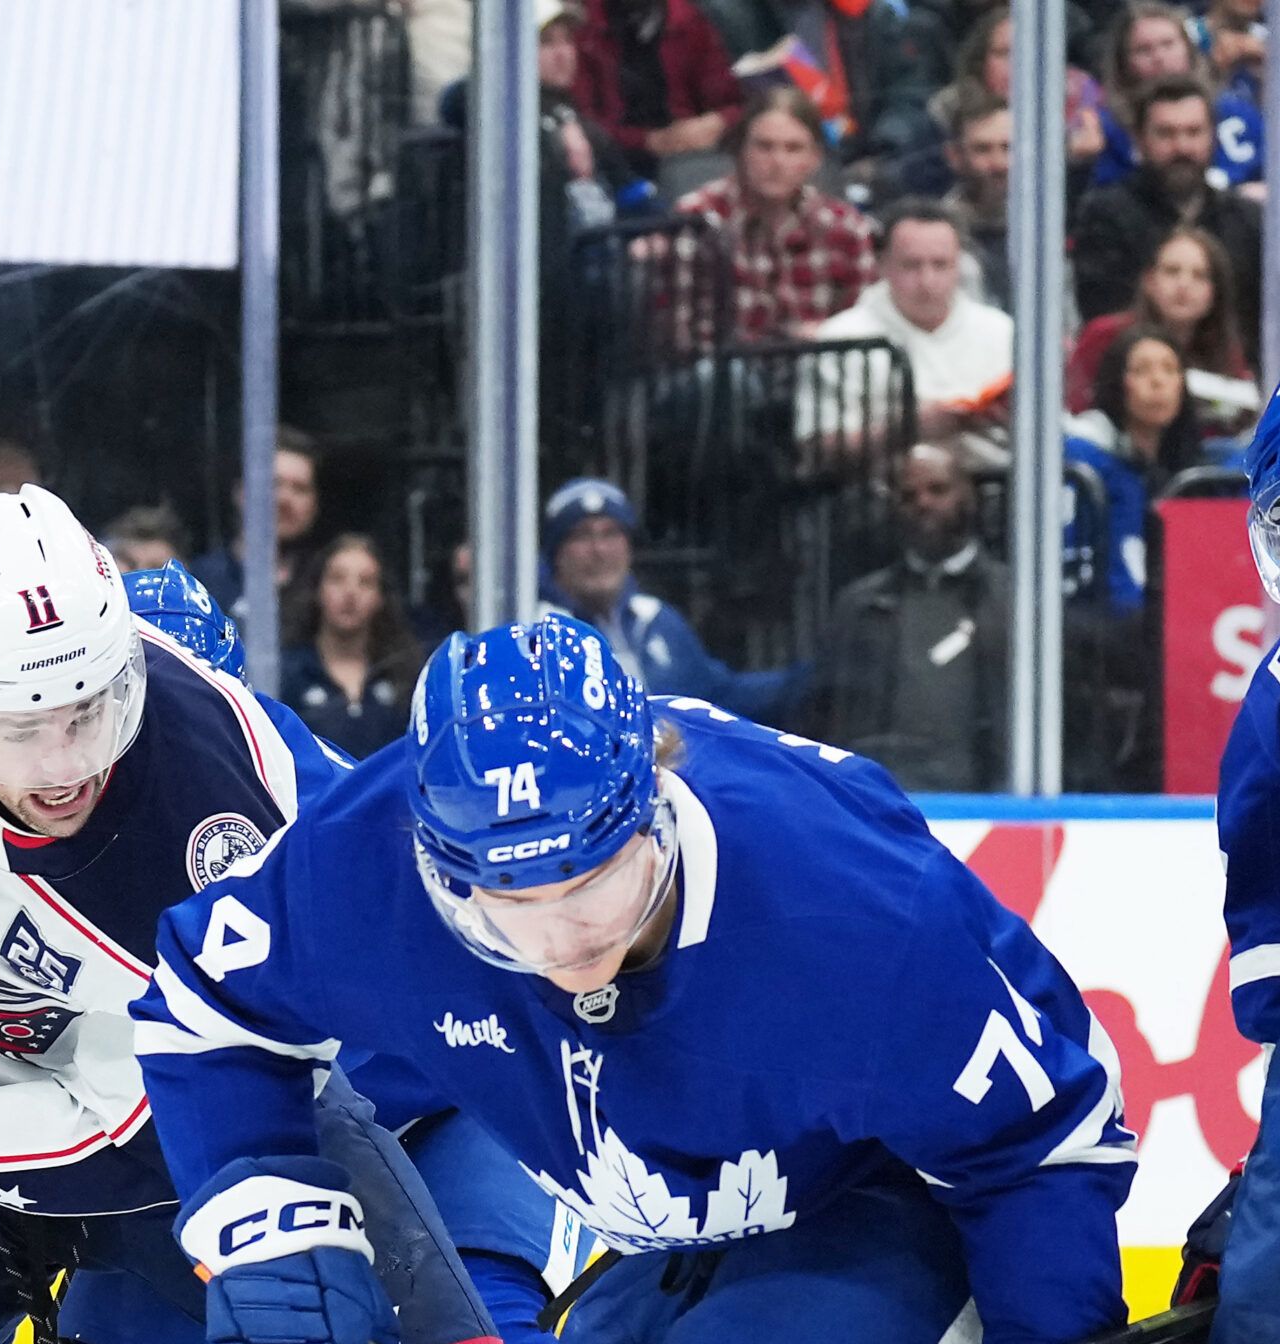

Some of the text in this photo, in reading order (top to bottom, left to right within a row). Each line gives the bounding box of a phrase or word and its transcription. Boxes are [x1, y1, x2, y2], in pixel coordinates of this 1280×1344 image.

[17, 585, 64, 634] 11
[21, 647, 86, 671] WARRIOR
[485, 761, 540, 817] 74
[222, 823, 260, 849] JACKET
[487, 833, 570, 863] CCM
[433, 1011, 516, 1054] Milk
